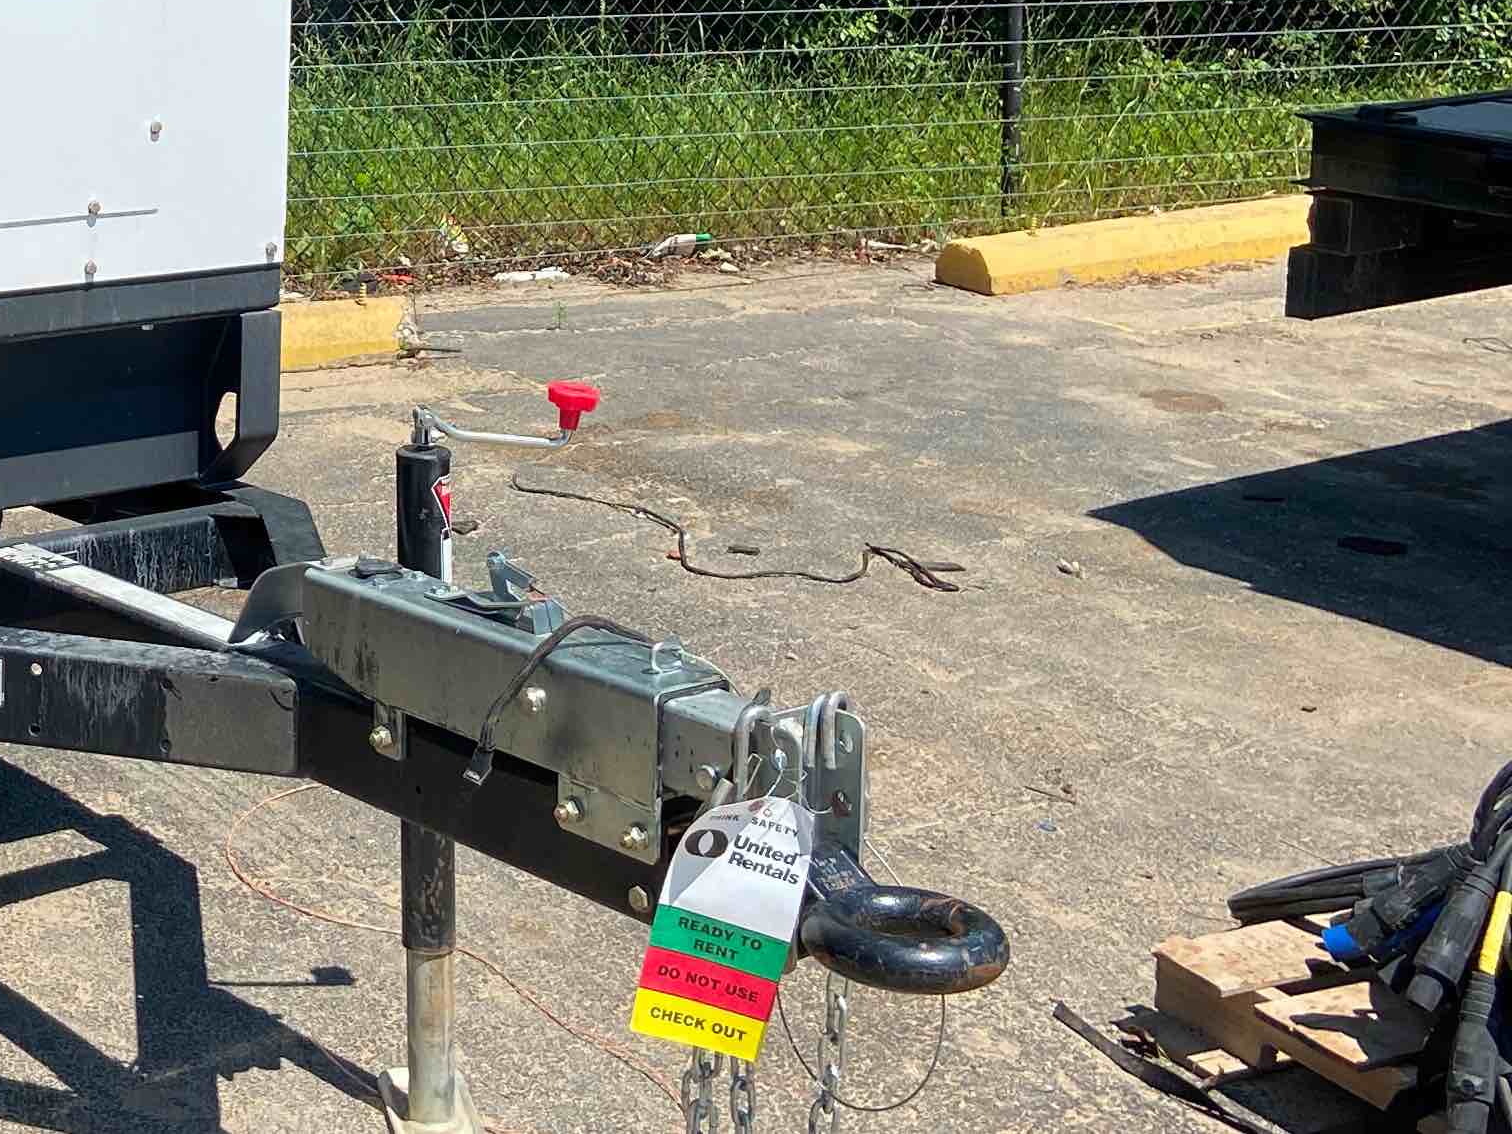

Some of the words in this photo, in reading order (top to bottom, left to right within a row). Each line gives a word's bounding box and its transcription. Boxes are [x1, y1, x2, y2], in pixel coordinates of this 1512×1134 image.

[751, 816, 799, 837] SAFETY
[734, 834, 799, 866] United
[728, 852, 799, 885] Rentals
[678, 916, 735, 941] READY
[741, 935, 762, 950] TO
[693, 939, 739, 960] RENT
[658, 964, 680, 979] DO
[685, 971, 721, 990] NOT
[725, 984, 760, 1003] USE
[650, 1006, 707, 1031] CHECK
[711, 1022, 747, 1042] OUT
